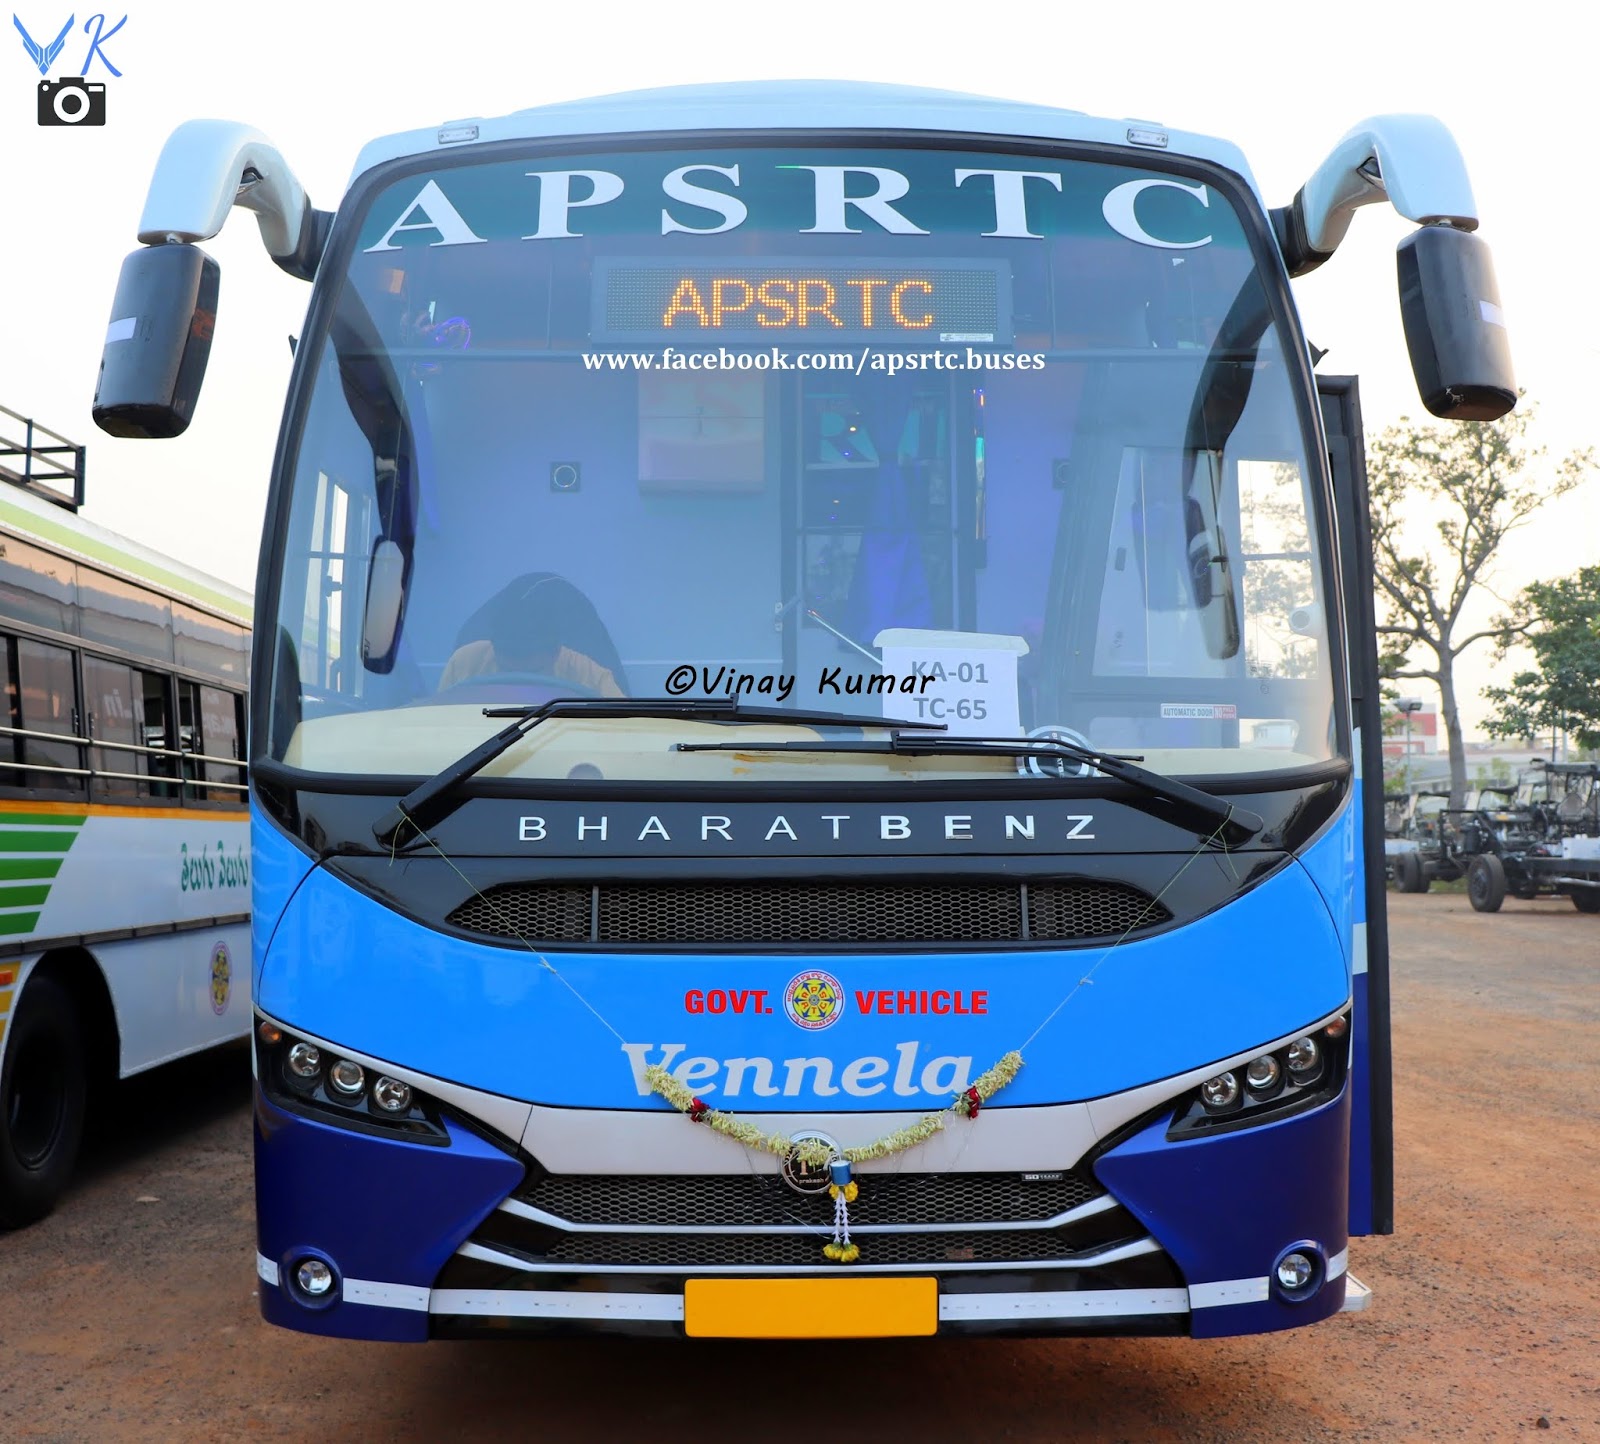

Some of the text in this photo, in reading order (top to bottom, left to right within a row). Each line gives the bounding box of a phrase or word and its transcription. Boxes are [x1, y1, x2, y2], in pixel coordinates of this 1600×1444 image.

[364, 162, 1214, 251] APSRTC
[662, 278, 934, 329] APSRTC
[911, 660, 989, 684] KA-01
[912, 696, 988, 721] TC-65
[1163, 707, 1197, 717] AUTOMATIC
[1197, 708, 1213, 717] DOOR
[518, 814, 1095, 841] BHARATBENZ
[685, 990, 988, 1014] GOVT. VEHICLE
[620, 1041, 973, 1098] Vennela
